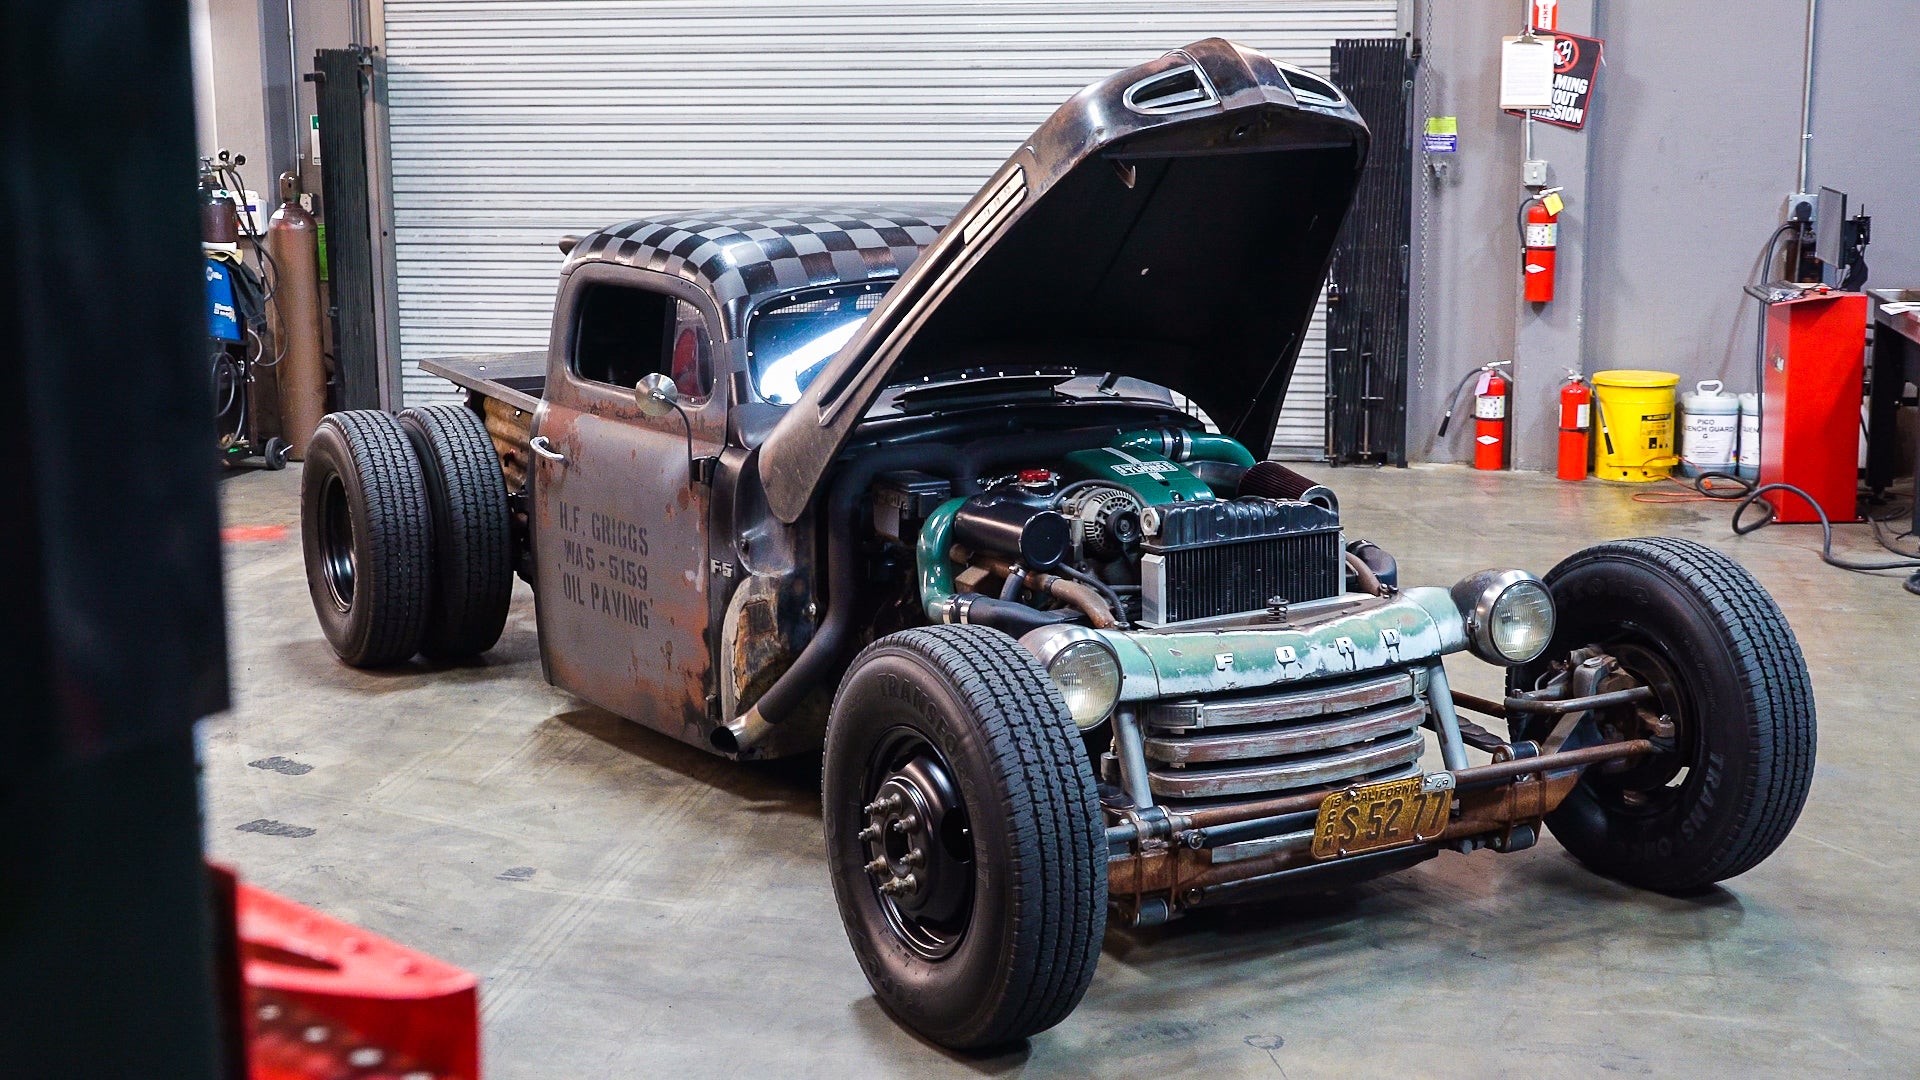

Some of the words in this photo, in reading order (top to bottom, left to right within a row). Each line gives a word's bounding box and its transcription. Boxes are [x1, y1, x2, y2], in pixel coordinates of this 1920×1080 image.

[1551, 88, 1579, 106] OUT
[1552, 73, 1588, 94] MING
[591, 512, 649, 557] GRIGGS
[1214, 628, 1400, 671] FORD
[1352, 782, 1420, 803] CALIFORNIA
[1339, 806, 1360, 845] S
[1366, 798, 1404, 839] 52
[1411, 790, 1445, 832] 77
